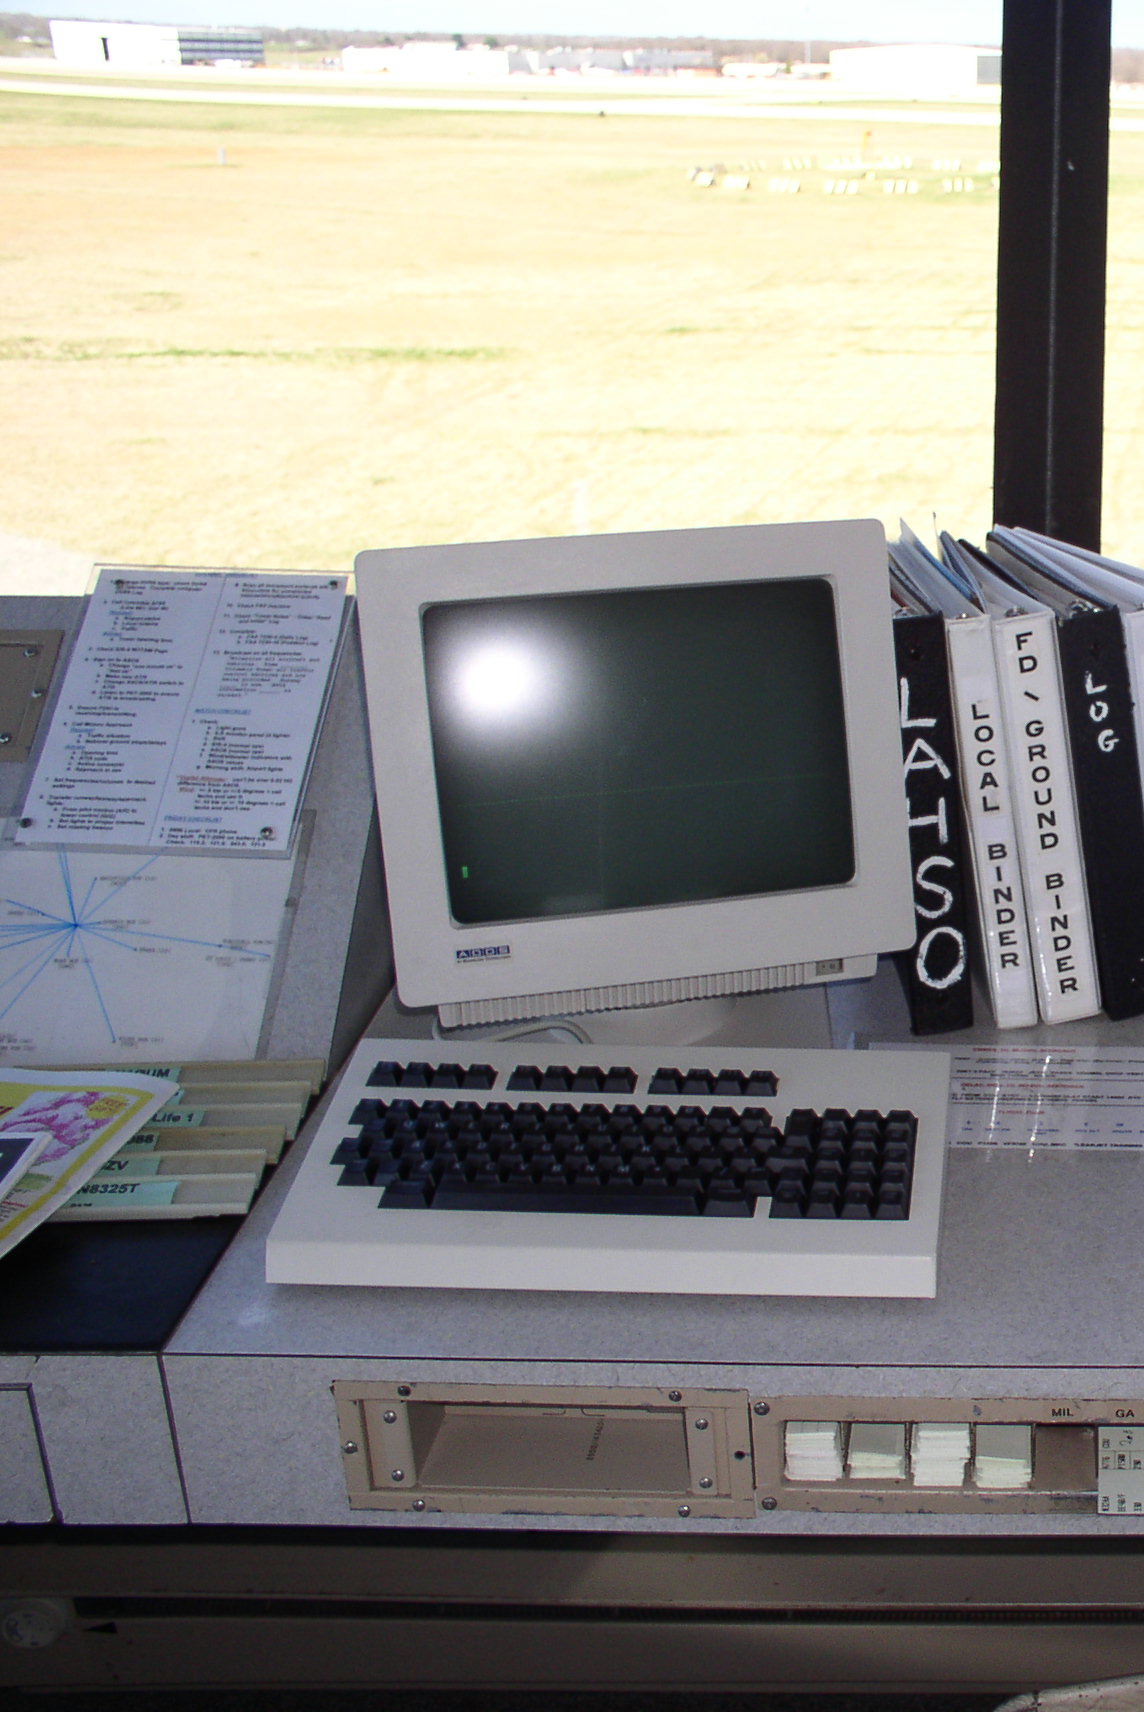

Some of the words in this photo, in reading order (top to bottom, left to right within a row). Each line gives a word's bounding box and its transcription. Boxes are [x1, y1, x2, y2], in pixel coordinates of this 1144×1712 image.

[1014, 631, 1039, 674] FD
[1083, 671, 1120, 753] LOG
[900, 676, 967, 990] LAHSO
[971, 703, 1000, 813] LOCAL
[988, 843, 1020, 969] BINDER
[1024, 719, 1059, 851] GROUND
[1045, 873, 1079, 995] BINDER
[1051, 1407, 1074, 1417] MIL
[1115, 1408, 1135, 1419] GA
